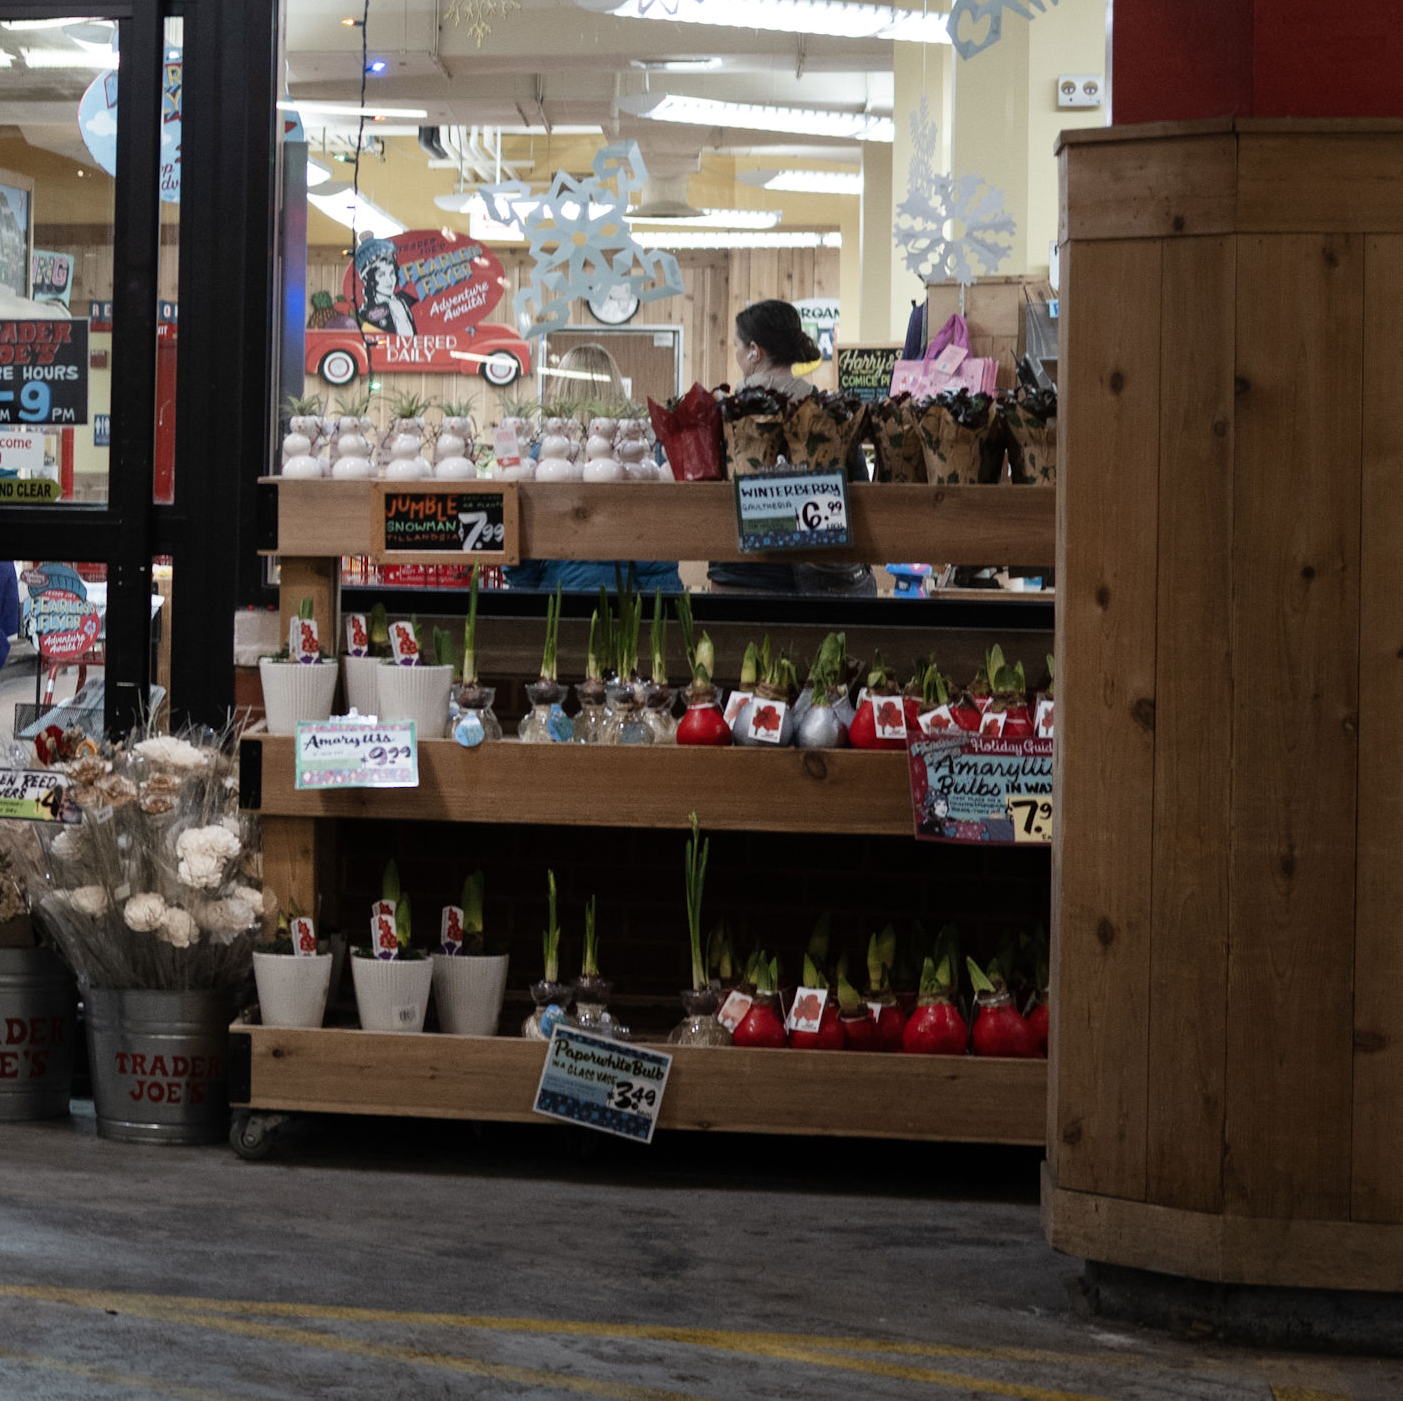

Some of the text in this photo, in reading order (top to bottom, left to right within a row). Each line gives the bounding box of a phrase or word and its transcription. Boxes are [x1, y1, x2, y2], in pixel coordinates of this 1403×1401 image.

[418, 263, 472, 298] FLYER
[430, 281, 489, 316] Adventure
[444, 294, 486, 323] Awaits!
[364, 335, 457, 349] DELIVERED
[387, 347, 435, 362] DAILY
[839, 350, 887, 377] Harry
[23, 365, 79, 380] HOURS
[842, 375, 878, 388] COMICE
[16, 483, 51, 498] CLEAR
[741, 483, 842, 498] WINTERBERRY
[385, 494, 457, 521] JUMBLE
[387, 520, 457, 533] SNOWMAN
[44, 633, 86, 646] Adventure
[970, 738, 1023, 757] Holiday
[1023, 739, 1052, 753] Guid
[934, 754, 1052, 782] Amarylli
[23, 774, 57, 789] REED
[937, 775, 1001, 797] Bulbs
[1005, 783, 1022, 794] IN
[114, 1051, 225, 1079] TRADER
[554, 1039, 665, 1082] Paperwhite Bulb
[567, 1063, 595, 1081] GLASS
[129, 1081, 211, 1105] JOE'S
